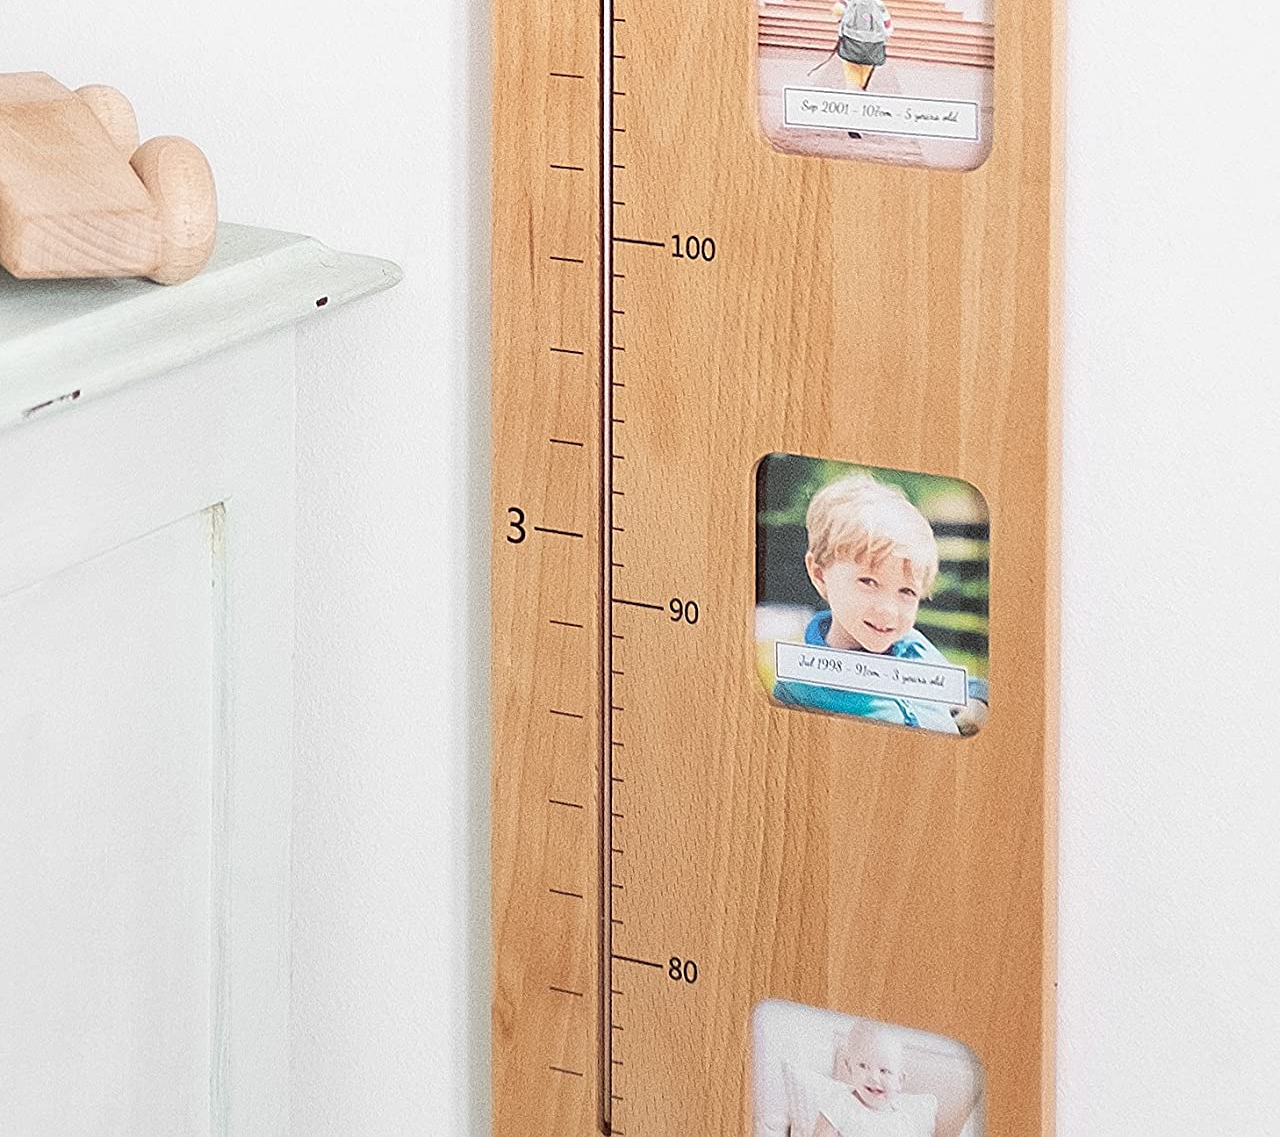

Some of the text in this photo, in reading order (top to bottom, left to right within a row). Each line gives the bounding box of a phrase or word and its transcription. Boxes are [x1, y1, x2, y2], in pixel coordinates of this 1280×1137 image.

[800, 99, 818, 113] Sep
[822, 101, 849, 116] 2001
[942, 111, 960, 123] old
[670, 234, 717, 263] 100
[506, 506, 527, 544] 3
[669, 597, 699, 625] 90
[817, 657, 844, 674] 1998
[669, 957, 698, 985] 80
